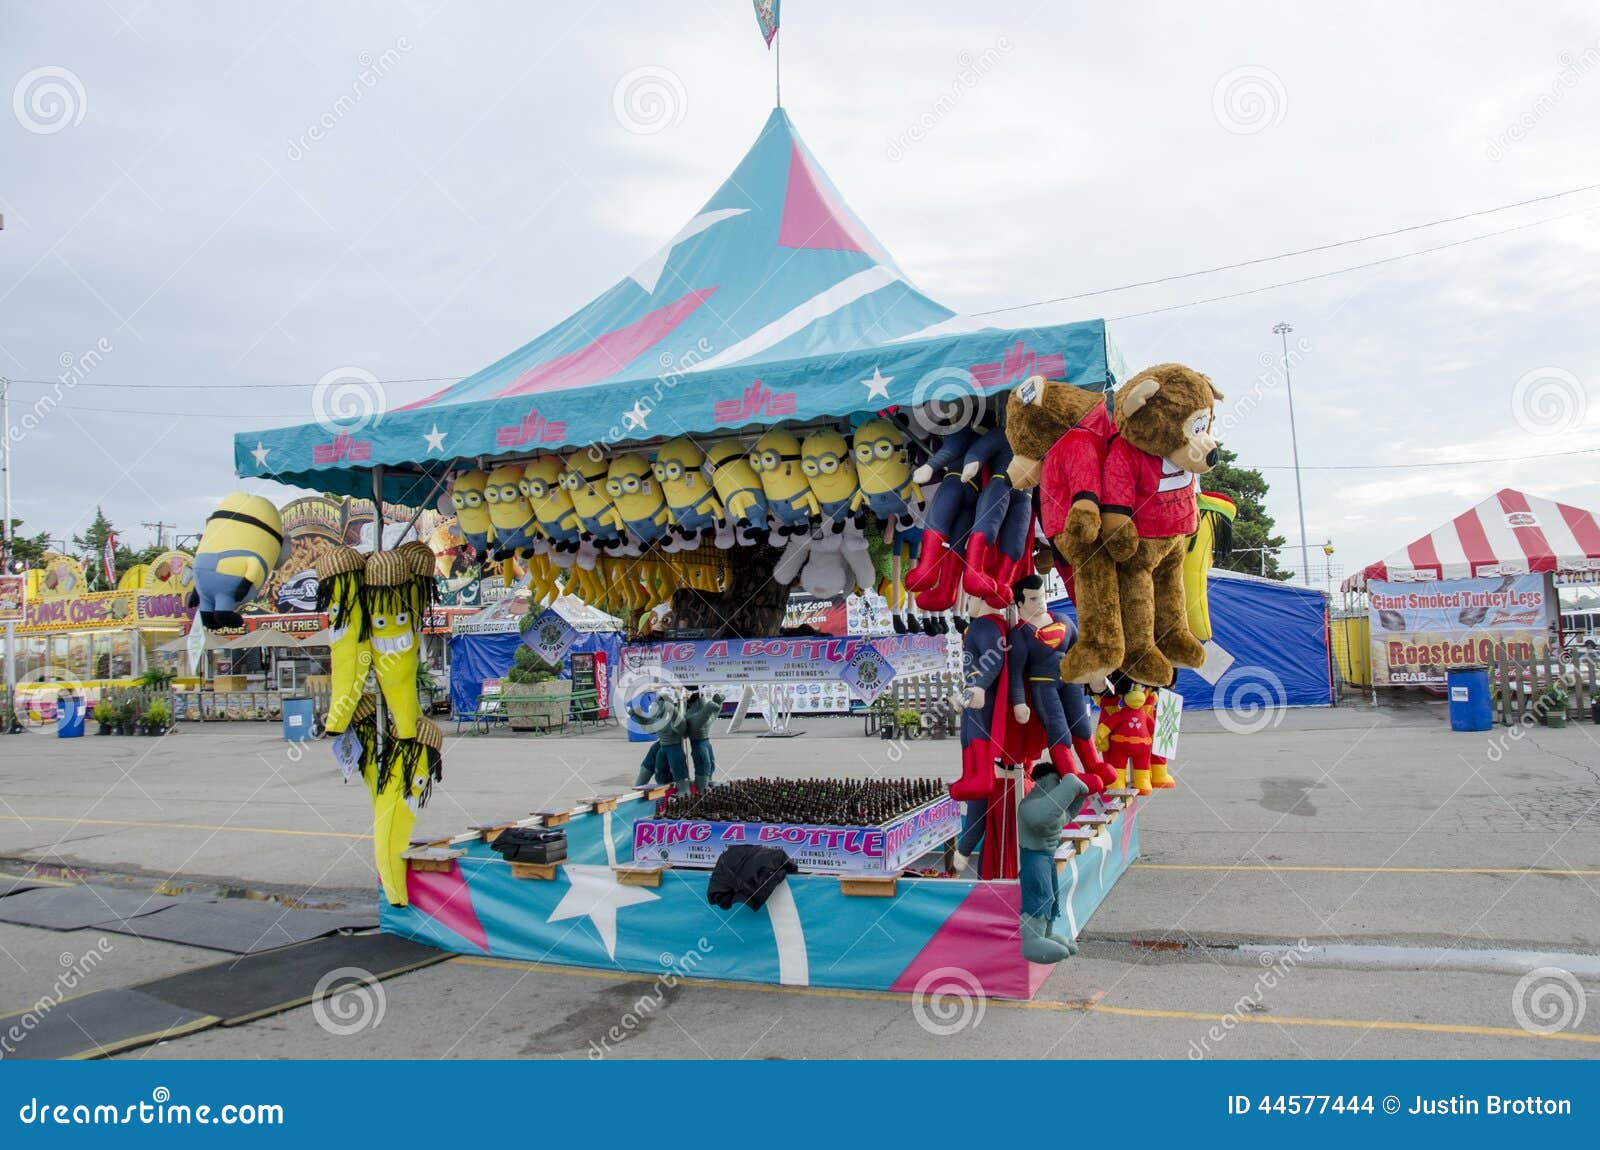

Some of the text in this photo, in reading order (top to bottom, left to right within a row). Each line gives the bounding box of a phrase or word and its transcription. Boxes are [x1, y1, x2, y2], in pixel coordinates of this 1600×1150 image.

[1555, 571, 1600, 584] ITALI
[1373, 590, 1541, 610] Giant Smoked Turkey Legs
[261, 619, 319, 632] CURLY FRIES
[457, 622, 480, 634] COOKIE
[704, 640, 728, 658] A
[741, 639, 863, 663] BOTTLE
[1388, 638, 1475, 666] Roasted
[1391, 672, 1426, 681] GRAB
[635, 822, 712, 849] RING
[721, 824, 745, 841] A
[759, 825, 884, 858] BOTTLE
[886, 818, 914, 860] RING
[917, 813, 926, 831] A
